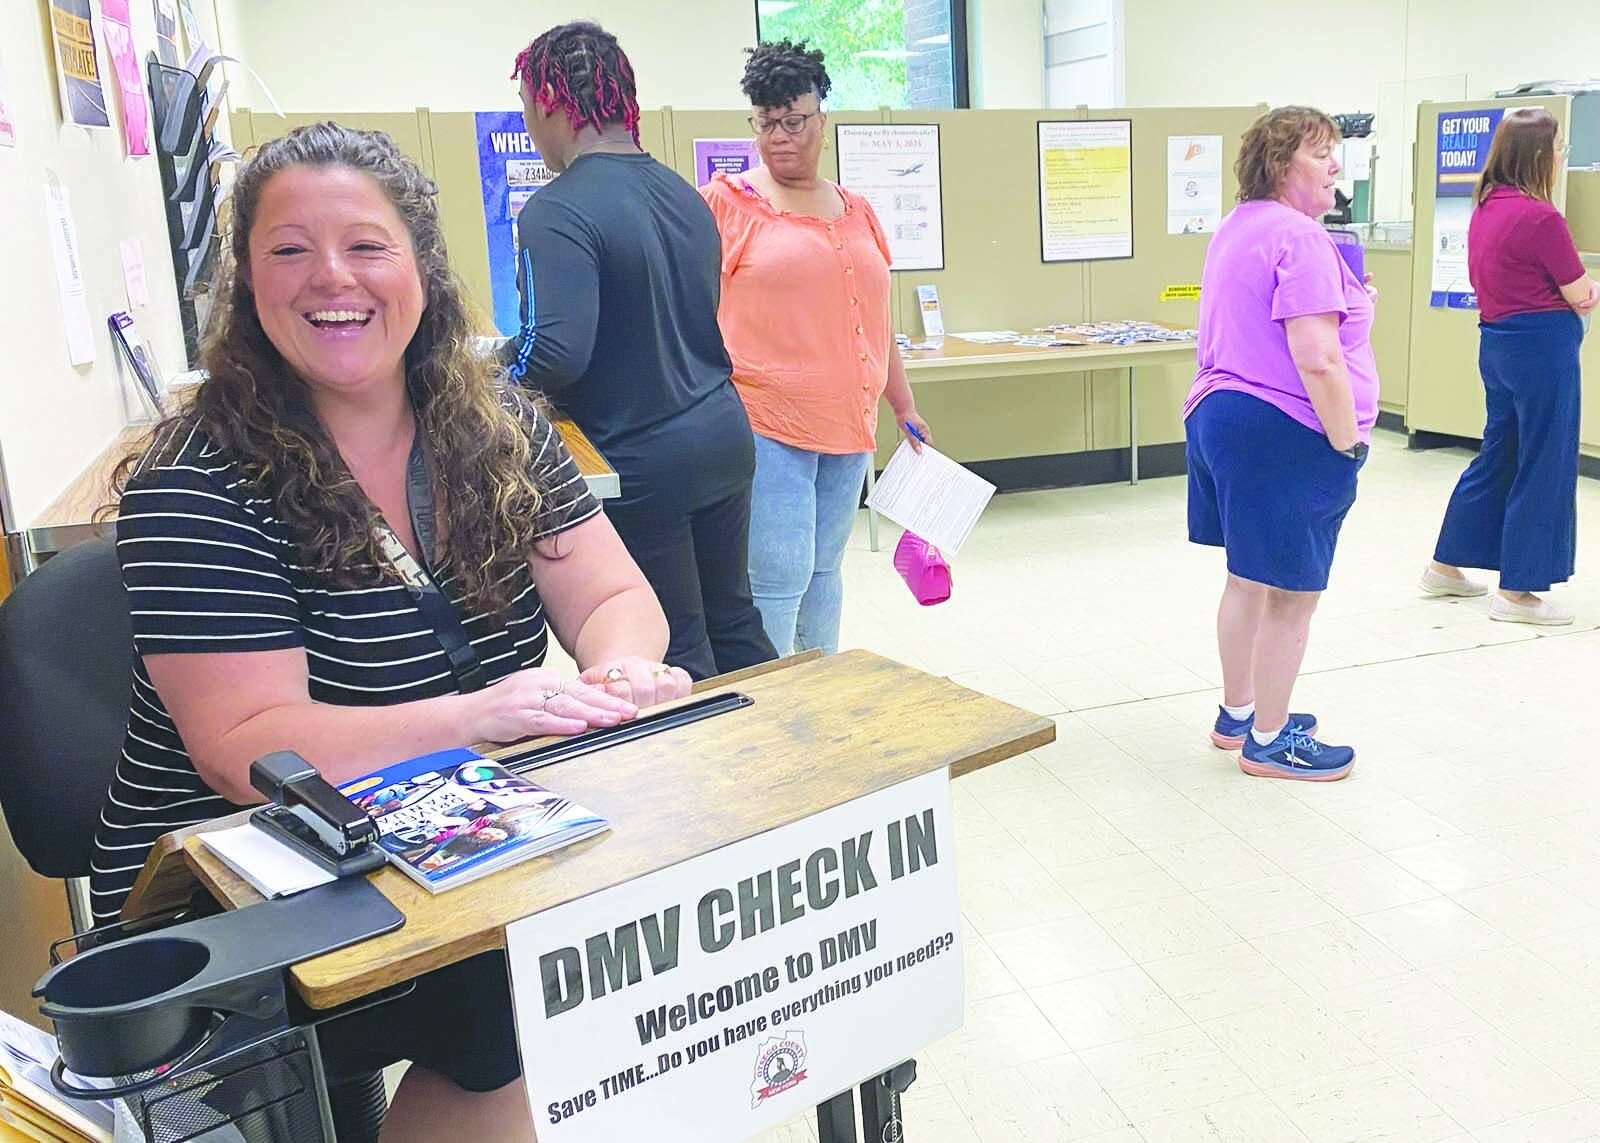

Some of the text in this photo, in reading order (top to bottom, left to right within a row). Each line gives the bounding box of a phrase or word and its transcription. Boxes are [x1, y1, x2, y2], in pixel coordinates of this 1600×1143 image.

[1442, 116, 1490, 135] GET YOUR
[1442, 133, 1478, 150] REAL ID
[1441, 150, 1477, 168] TODAY!
[539, 808, 938, 1020] DMV CHECK IN
[634, 918, 878, 1046] Welcome to DMV
[547, 932, 954, 1125] Save TIME...Do you have everything you need??
[756, 1040, 805, 1078] OTSEGO COUNTY
